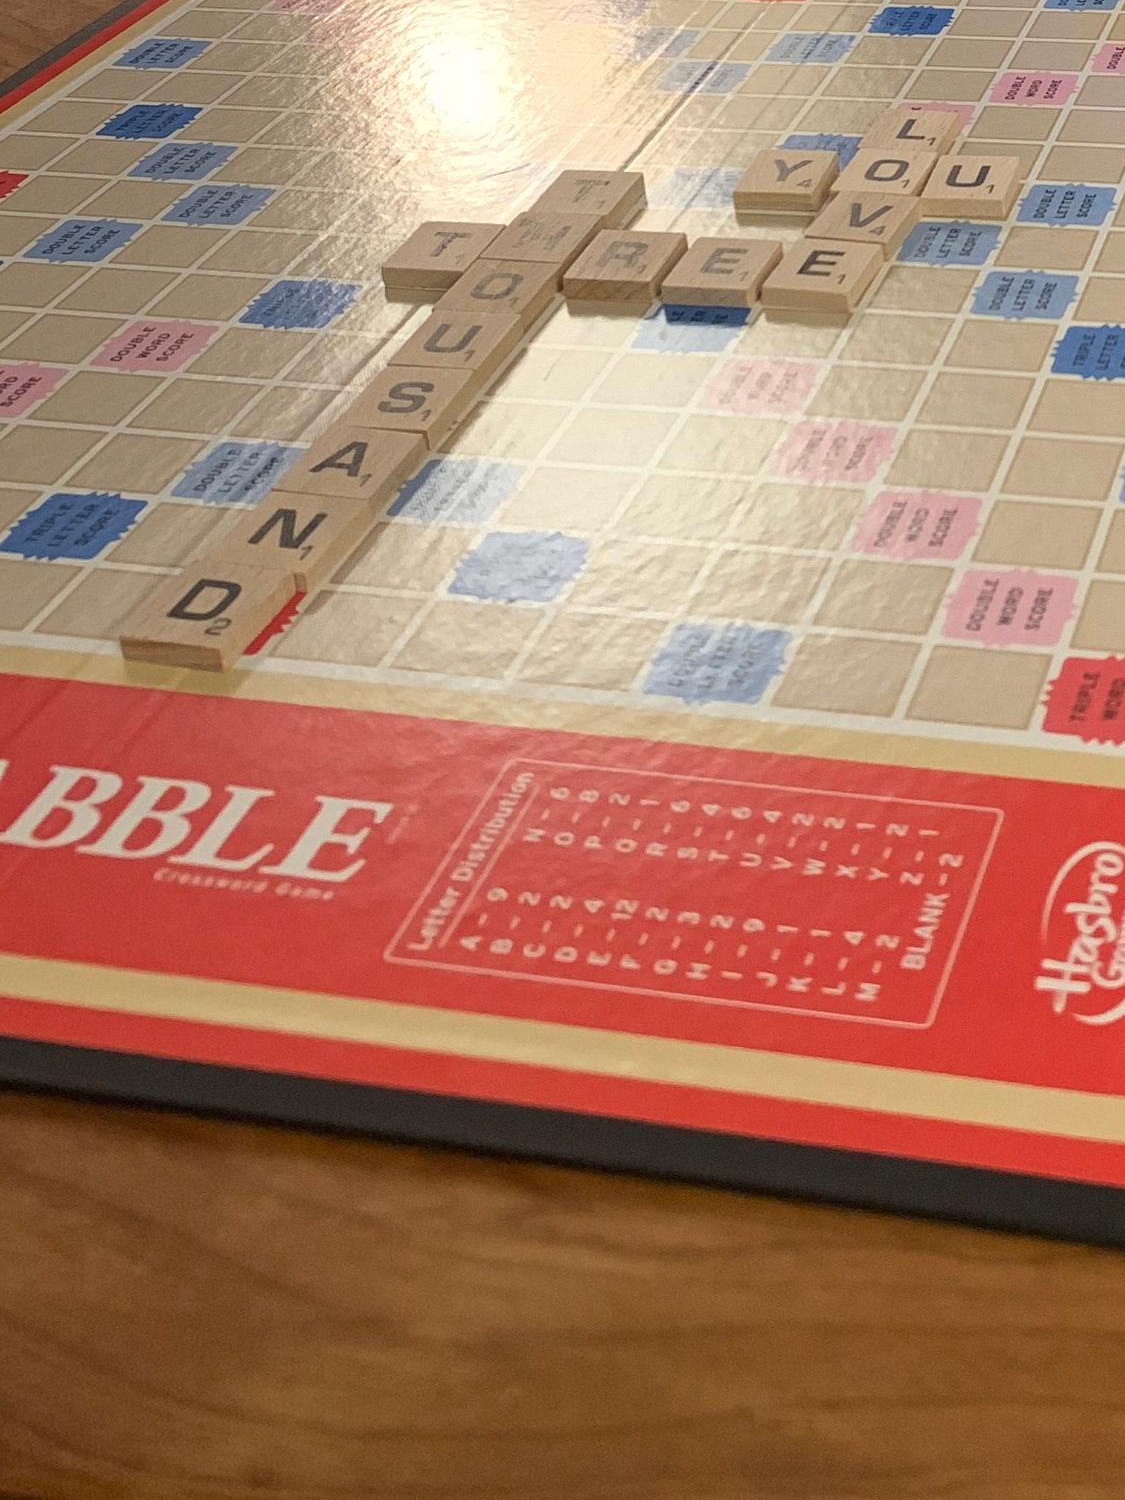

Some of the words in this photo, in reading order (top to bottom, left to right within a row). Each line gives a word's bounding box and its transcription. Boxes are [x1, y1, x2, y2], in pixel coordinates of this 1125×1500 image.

[127, 42, 165, 63] DOUBLE
[144, 43, 180, 63] LETTER
[162, 45, 194, 62] SCORE
[1105, 47, 1125, 69] DOUBLE
[1003, 76, 1027, 99] DOUBLE
[1024, 80, 1043, 97] WORD
[1042, 80, 1062, 99] SCORE
[143, 147, 184, 173] DOUBLE
[161, 149, 202, 174] LETTER
[181, 151, 217, 173] SCORE
[177, 190, 220, 217] DOUBLE
[196, 191, 238, 218] LETTER
[218, 194, 254, 217] SCORE
[1032, 189, 1057, 218] DOUBLE
[1053, 190, 1078, 218] LETTER
[1075, 194, 1097, 217] SCORE
[40, 225, 87, 254] DOUBLE
[60, 226, 105, 254] LETTER
[82, 229, 121, 253] SCORE
[913, 227, 941, 257] DOUBLE
[934, 228, 962, 258] LETTER
[957, 232, 982, 257] SCORE
[988, 277, 1016, 310] DOUBLE
[1010, 279, 1038, 311] LETTER
[1034, 282, 1059, 310] SCORE
[108, 327, 158, 362] DOUBLE
[134, 333, 173, 358] WORD
[153, 333, 195, 361] SCORE
[1072, 334, 1098, 366] TRIPLE
[1095, 334, 1122, 370] LETTER
[0, 376, 44, 407] SCORE
[23, 504, 76, 544] TRIPLE
[44, 504, 101, 548] LETTER
[71, 509, 121, 546] SCORE
[872, 501, 909, 547] DOUBLE
[901, 509, 931, 543] WORD
[927, 509, 958, 547] SCORE
[964, 579, 1000, 630] DOUBLE
[995, 588, 1025, 625] WORD
[1022, 588, 1053, 630] SCORE
[1069, 671, 1102, 722] TRIPLE
[0, 759, 394, 883] BBLE
[403, 886, 466, 952] Letter
[447, 771, 537, 882] Distribution
[899, 892, 951, 971] BLANK
[1035, 852, 1124, 1013] Hasbro
